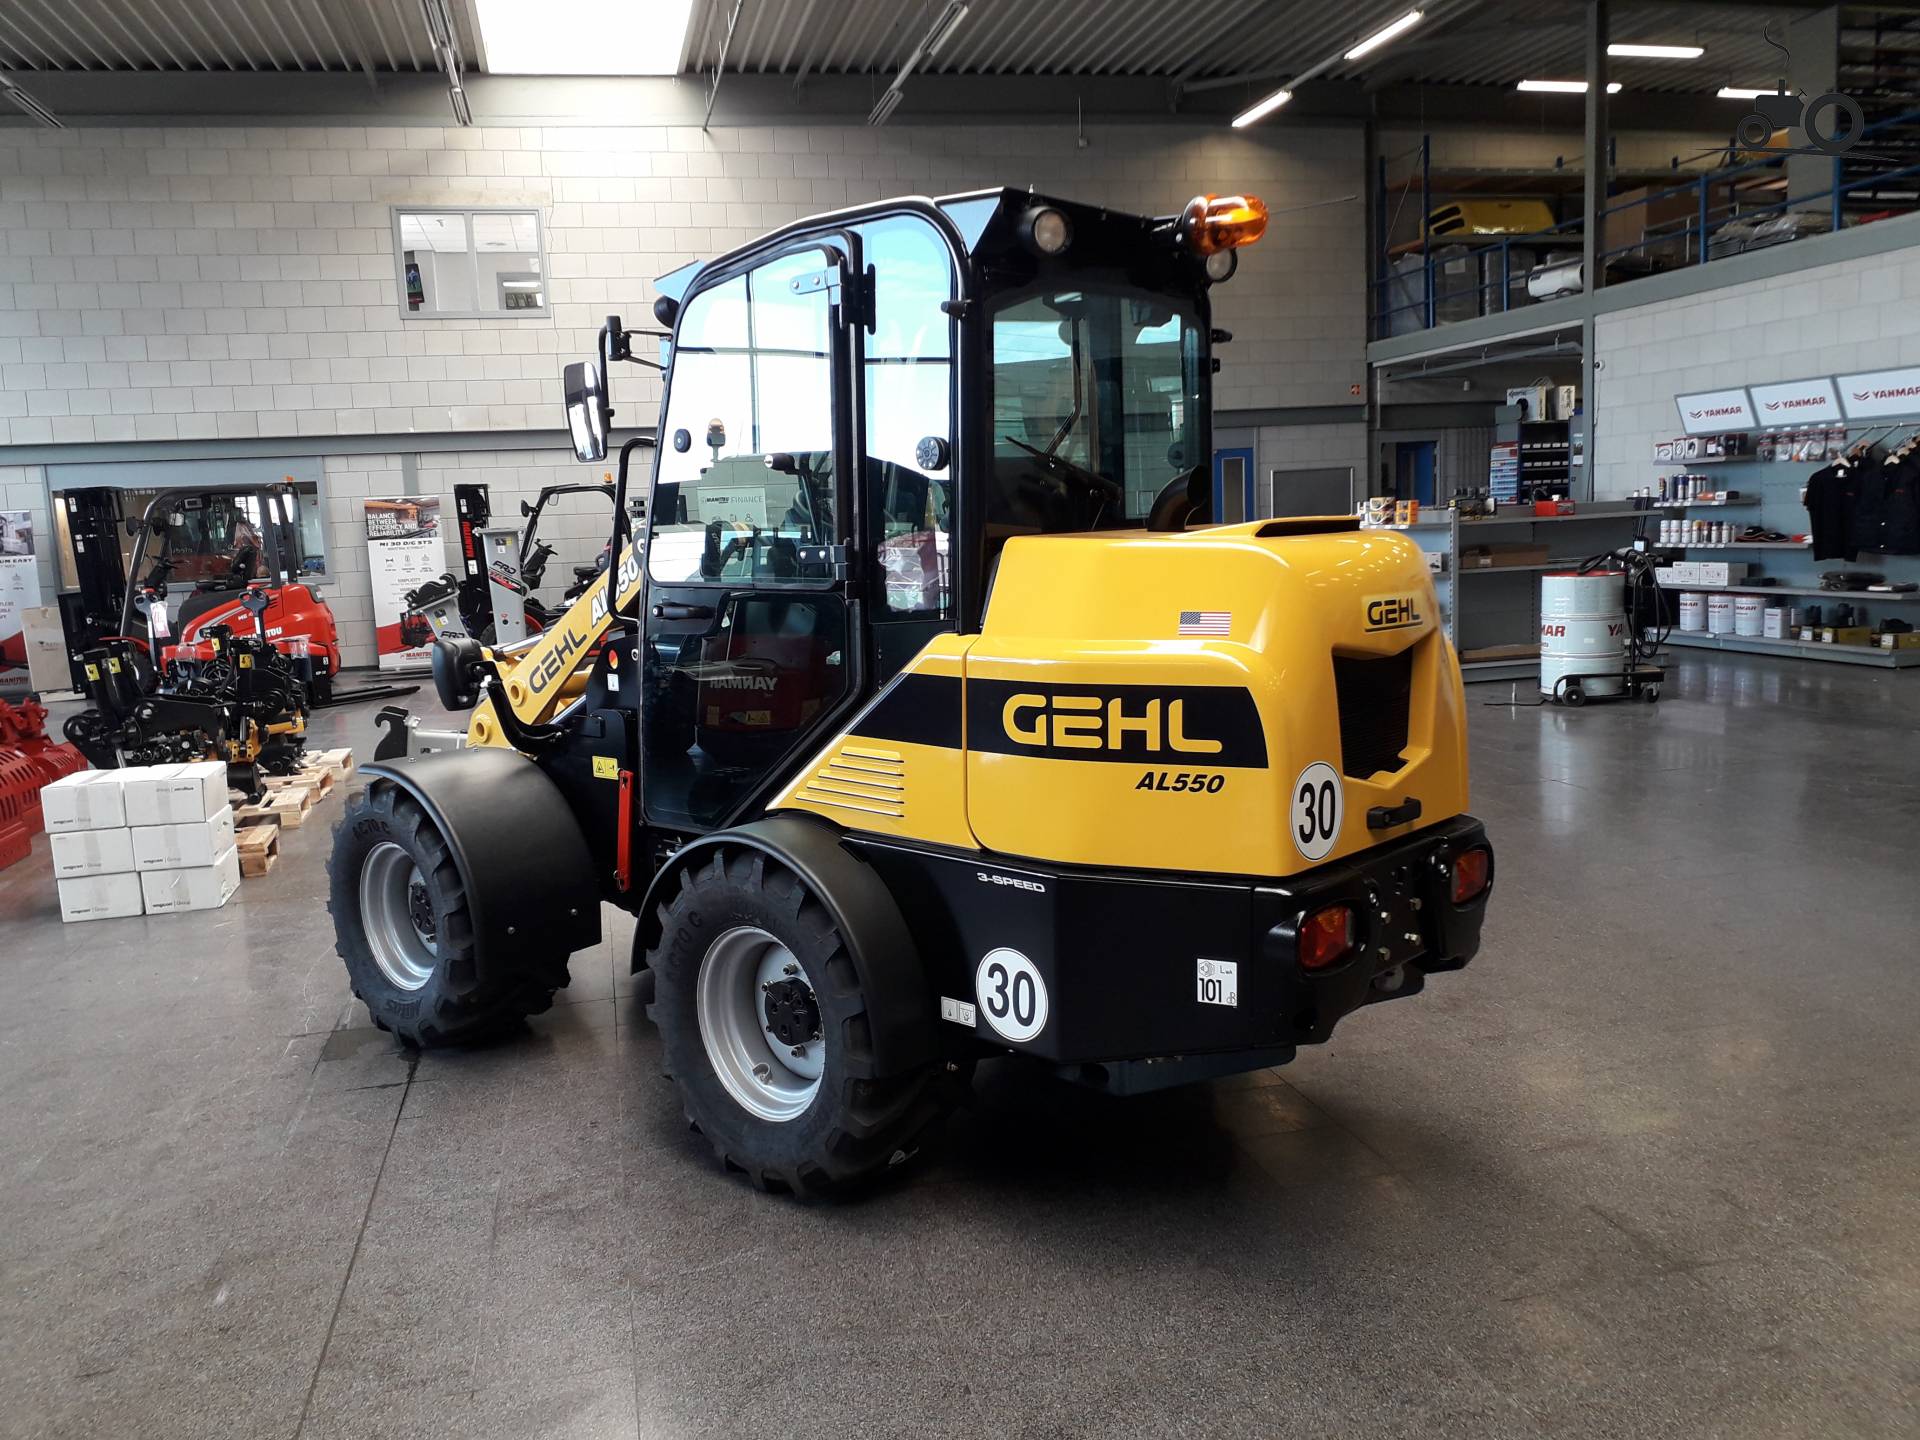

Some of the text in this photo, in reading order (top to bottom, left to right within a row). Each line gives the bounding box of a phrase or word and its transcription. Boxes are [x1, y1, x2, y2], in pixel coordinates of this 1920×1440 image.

[1781, 396, 1826, 409] YANMAR
[1872, 385, 1920, 399] YANMAR
[1704, 406, 1742, 418] YANMAR
[730, 496, 764, 504] FINANCE
[1367, 597, 1422, 626] GEHL
[529, 628, 588, 694] GEHL
[1002, 693, 1223, 754] GEHL
[1135, 771, 1225, 794] AL550
[1298, 779, 1336, 844] 30
[976, 872, 1046, 893] 3-SPEED
[986, 962, 1036, 1027] 30
[1199, 977, 1222, 1003] 101
